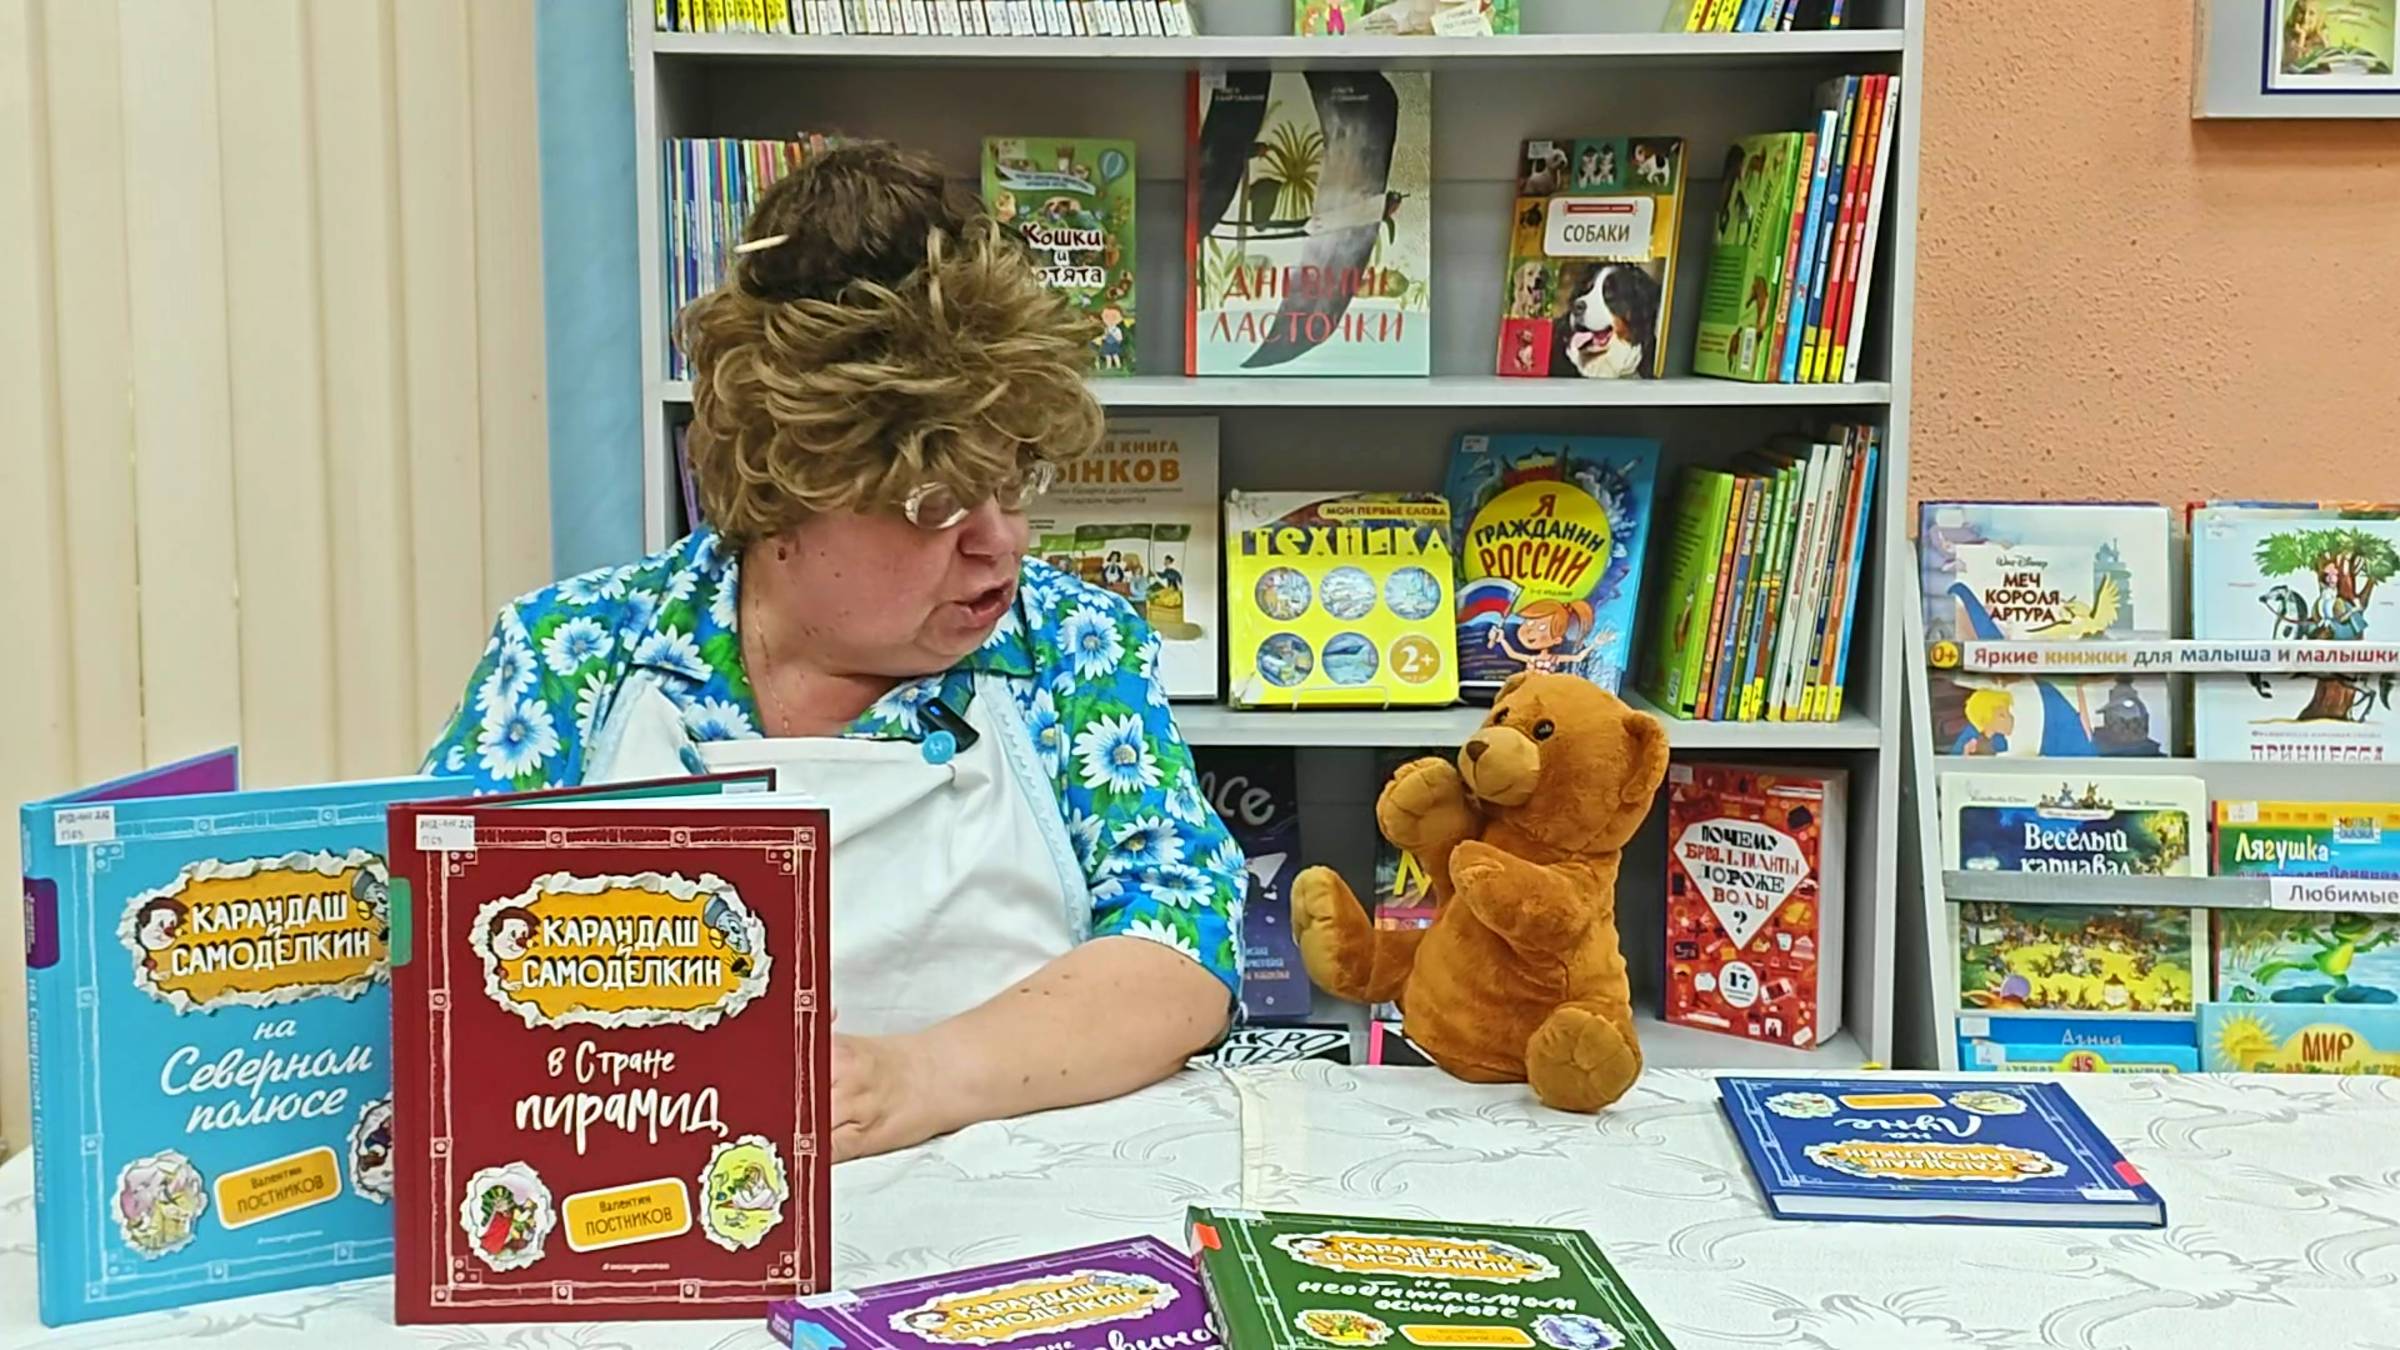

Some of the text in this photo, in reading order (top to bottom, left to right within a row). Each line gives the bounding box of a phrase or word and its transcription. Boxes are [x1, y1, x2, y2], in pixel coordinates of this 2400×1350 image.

[1022, 223, 1102, 247] Кошки
[1562, 223, 1631, 243] СОБАКИ
[1056, 250, 1068, 262] и
[1039, 268, 1103, 284] отята
[1209, 310, 1404, 344] ЛАСТОЧКИ
[1119, 440, 1180, 454] КНИГА
[1055, 458, 1181, 484] ЫНКОВ
[1357, 506, 1403, 516] ПЕРВЫЕ
[1406, 506, 1447, 517] СЛОВА
[1530, 493, 1557, 518] Я
[1474, 518, 1605, 552] ГРАЖДАНИН
[1478, 541, 1593, 588] РОССИИ
[2002, 572, 2041, 588] МЕЧ
[1985, 588, 2060, 606] КОРОЛЯ
[1990, 606, 2057, 623] АРТУРА
[1399, 645, 1435, 673] 2+
[1931, 645, 1958, 665] 0+
[1973, 645, 2400, 669] Яркие книжки для малыша и малышки
[1701, 824, 1778, 852] ПОЧЕМУ
[2234, 832, 2340, 870] Лягушка-
[2289, 884, 2400, 905] Любимые
[191, 890, 349, 935] КАРАНДАШ
[543, 915, 700, 949] КАРАНДАШ
[1729, 971, 1753, 990] 17
[252, 1017, 297, 1042] на
[2061, 1028, 2123, 1045] Агния
[2301, 1031, 2355, 1063] МИР
[160, 1043, 373, 1097] Северном
[547, 1040, 676, 1084] в Стране
[185, 1086, 349, 1134] полюсе
[515, 1086, 730, 1155] пирамид
[1833, 1114, 1983, 1139] Луне
[249, 1166, 303, 1191] Валентин
[236, 1174, 326, 1215] ПОСТНИКОВ
[598, 1193, 652, 1214] Валентин
[585, 1206, 674, 1238] ПОСТНИКОВ
[1338, 1240, 1488, 1263] КАРАНДАШ
[955, 1283, 1100, 1320] КАРАНДАШ
[1297, 1279, 1578, 1313] необитаемом
[1373, 1297, 1520, 1320] острове
